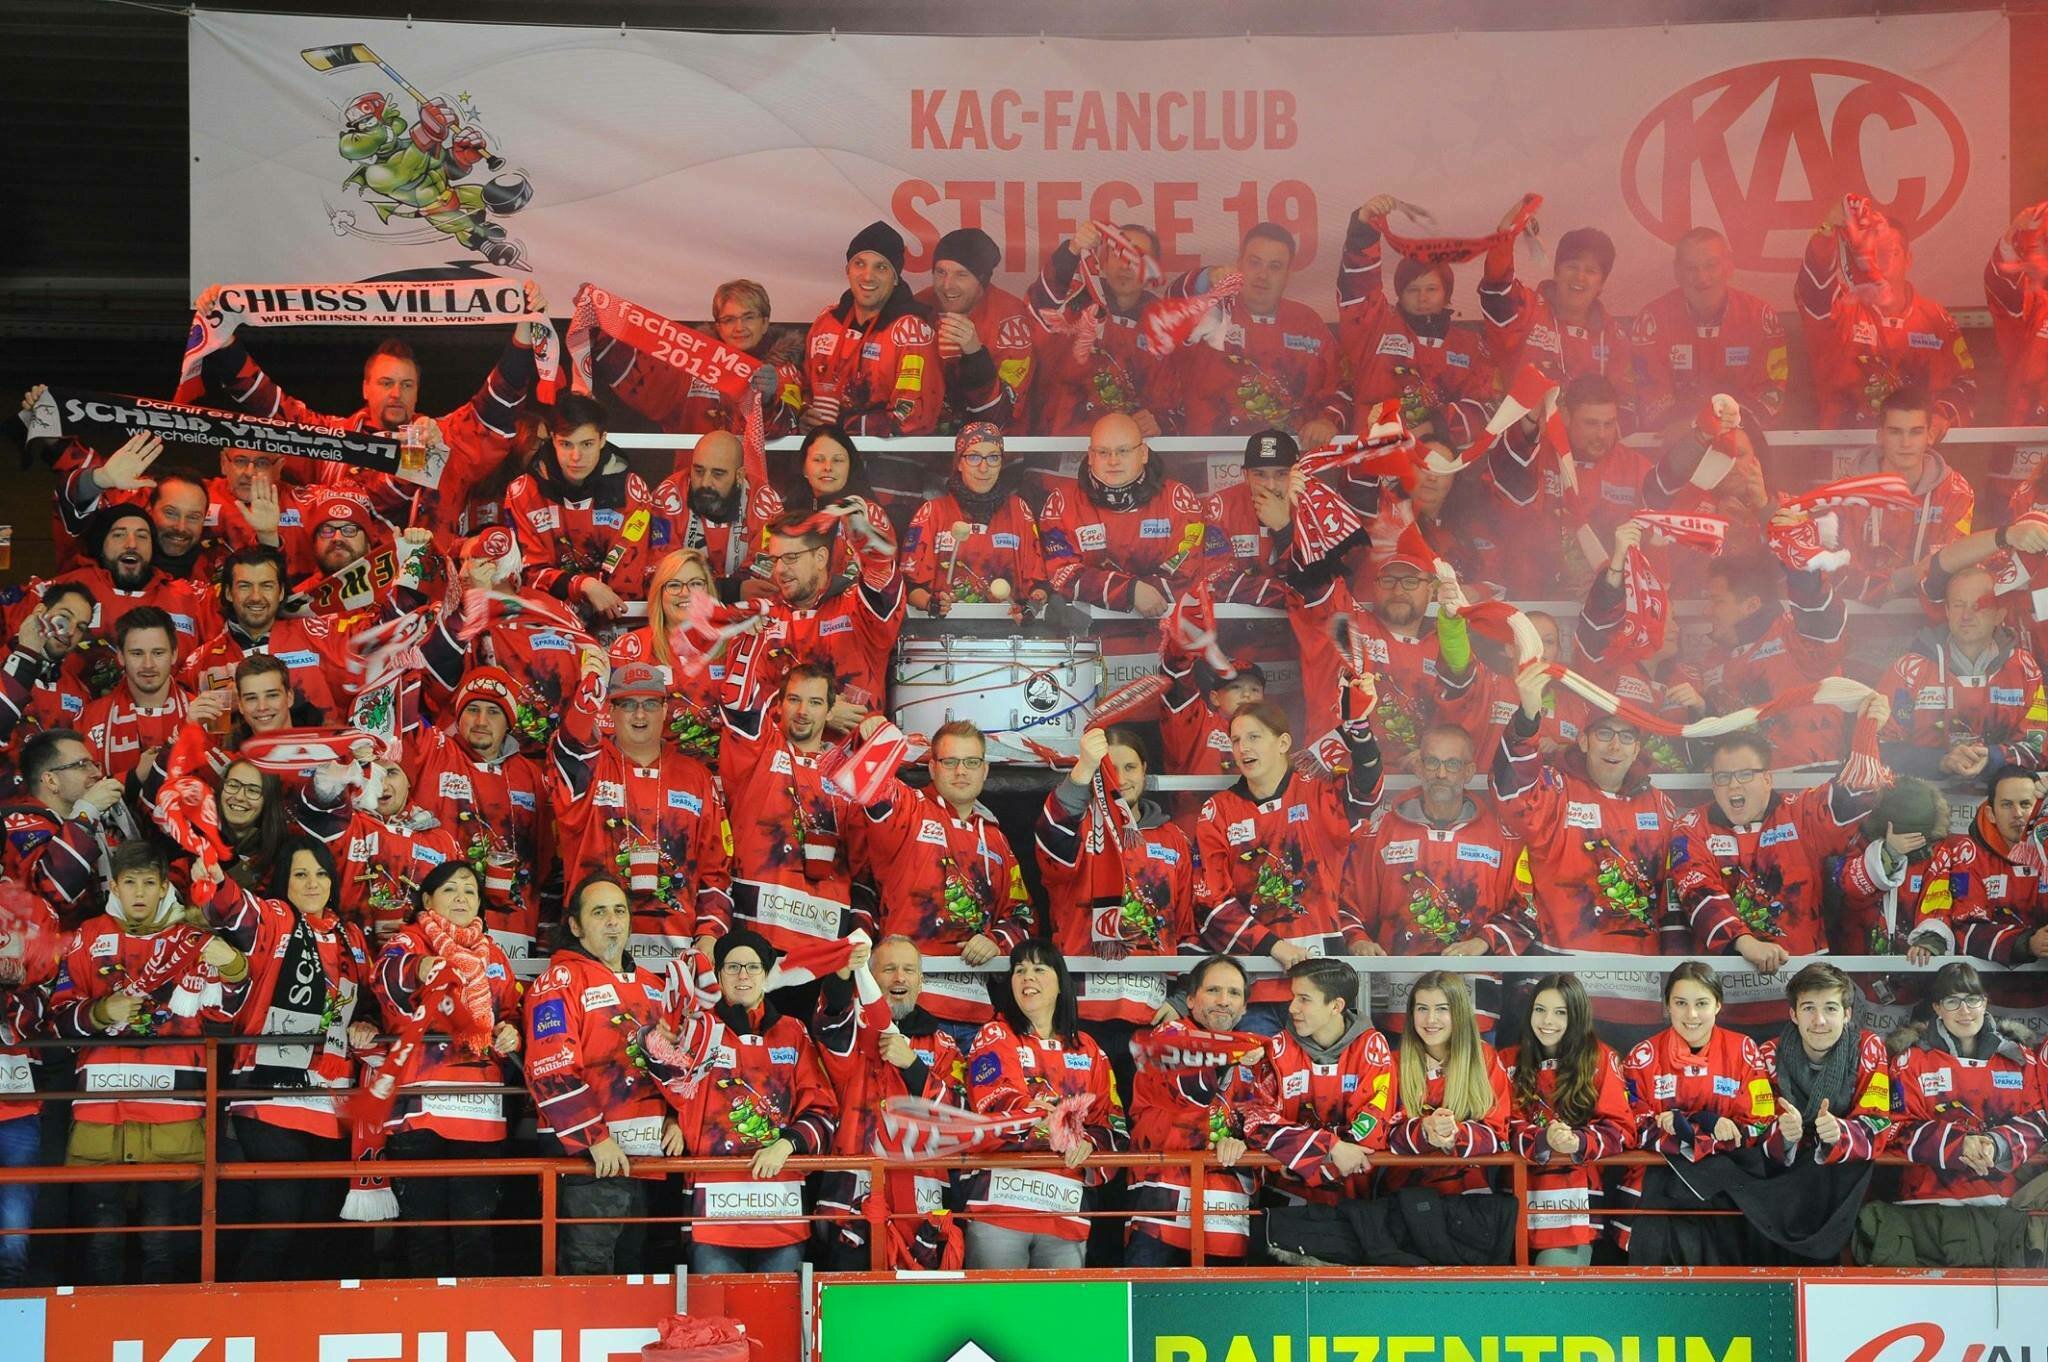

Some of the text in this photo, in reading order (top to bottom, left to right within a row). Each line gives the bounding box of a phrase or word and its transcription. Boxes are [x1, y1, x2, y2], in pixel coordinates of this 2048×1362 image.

[911, 89, 1299, 151] KAC-FANCLUB
[1655, 64, 1930, 262] KAC
[1223, 179, 1319, 272] 19
[206, 289, 367, 328] SCHEISS
[261, 315, 290, 323] WIR
[617, 301, 707, 353] facher
[711, 345, 754, 383] Me
[651, 340, 722, 385] 2013
[136, 399, 346, 439] Damit es jeder weiß
[154, 430, 231, 447] scheißen
[234, 436, 264, 450] auf
[266, 441, 343, 461] blau-weiß
[1107, 663, 1162, 682] HELISNI
[1022, 714, 1061, 726] crocs
[92, 1073, 171, 1089] TSCELISNIG
[710, 1192, 799, 1209] TSCHELISNIG
[995, 1175, 1081, 1205] TSCHELISNIG
